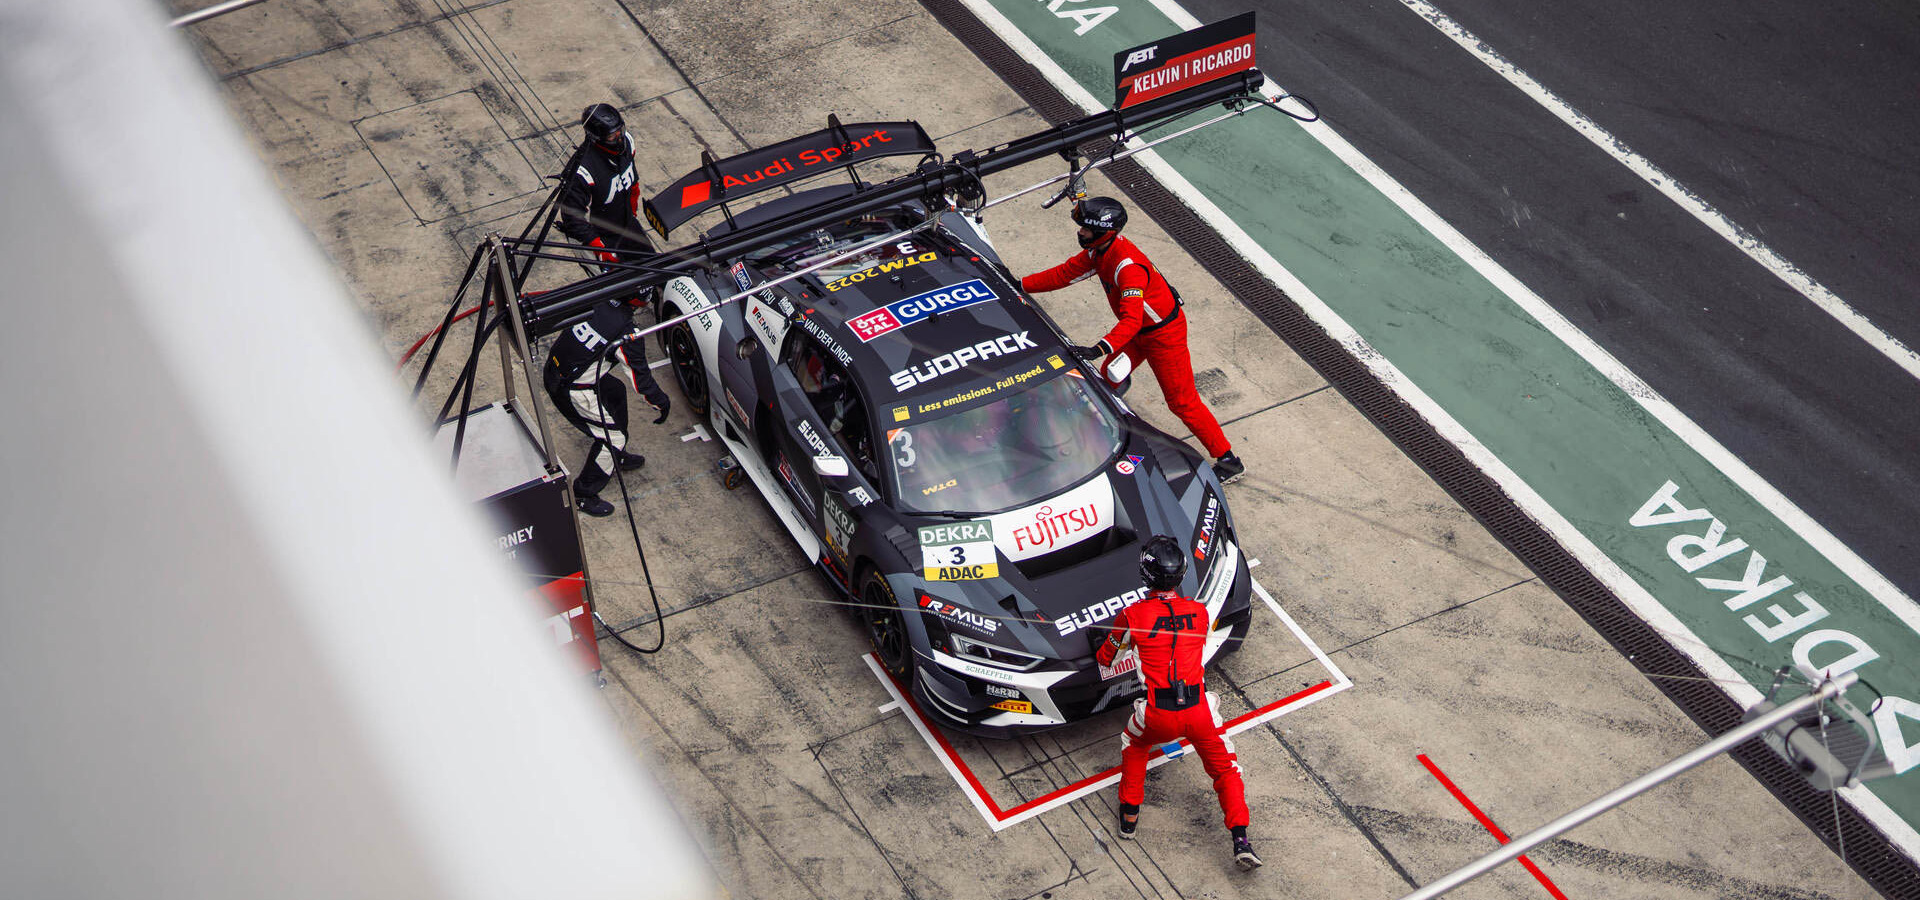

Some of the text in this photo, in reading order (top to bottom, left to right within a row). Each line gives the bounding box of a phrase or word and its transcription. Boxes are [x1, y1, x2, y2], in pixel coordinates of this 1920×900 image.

[1121, 46, 1158, 72] ABT
[1133, 43, 1252, 94] KELVIN RICARDO
[722, 128, 893, 190] Audi Sport
[646, 207, 665, 237] DTM
[1084, 218, 1113, 228] uvex
[896, 241, 917, 254] 3
[825, 252, 937, 292] DTM 2023
[671, 279, 712, 331] SCHAEFFER
[897, 283, 990, 319] GURGL
[1123, 289, 1141, 298] DTM
[572, 321, 608, 351] BT
[754, 311, 778, 345] REMUS
[855, 312, 888, 330] ÖTZ
[861, 321, 894, 337] TAL
[803, 319, 853, 367] VAN DER LINDE
[889, 330, 1039, 393] SÜDPACK
[918, 366, 1046, 414] Less emissions. Full Speed.
[895, 430, 916, 468] 3
[1118, 462, 1133, 473] E
[848, 486, 874, 507] ABT
[824, 490, 855, 535] DEKRA
[1012, 504, 1099, 552] FUJITSU
[1197, 497, 1218, 554] REMUS
[920, 524, 990, 544] DEKRA
[949, 546, 966, 565] 3
[938, 565, 984, 580] ADAC
[1628, 479, 1881, 690] DEKRA
[926, 600, 997, 632] REMUS
[1147, 614, 1197, 639] ABT
[965, 665, 1013, 681] SCHAEFFLER
